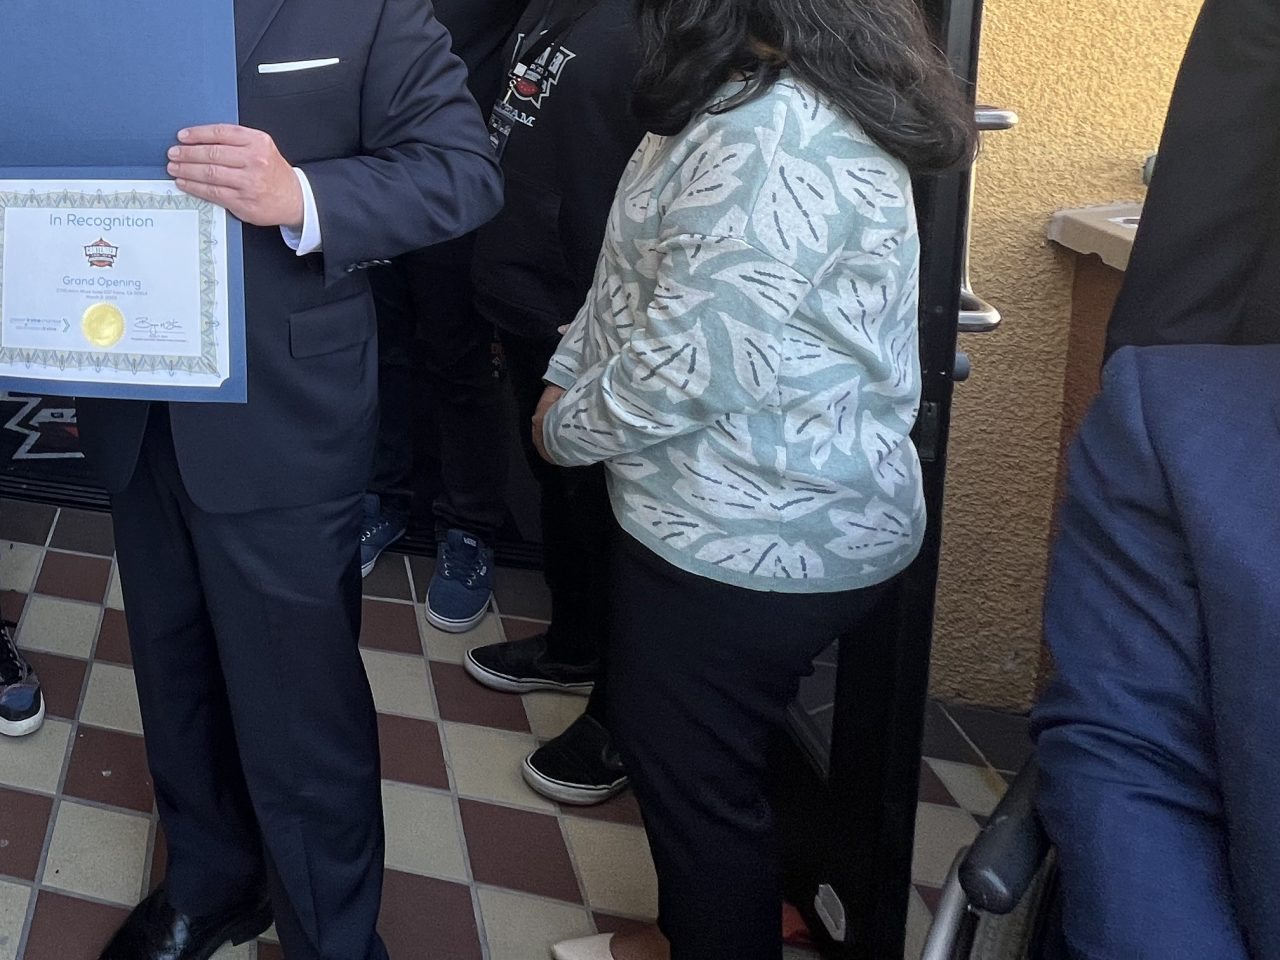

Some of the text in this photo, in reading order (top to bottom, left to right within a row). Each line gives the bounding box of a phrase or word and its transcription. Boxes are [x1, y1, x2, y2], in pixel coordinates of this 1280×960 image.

[49, 213, 154, 231] In Recognition
[62, 276, 141, 290] Grand Opening
